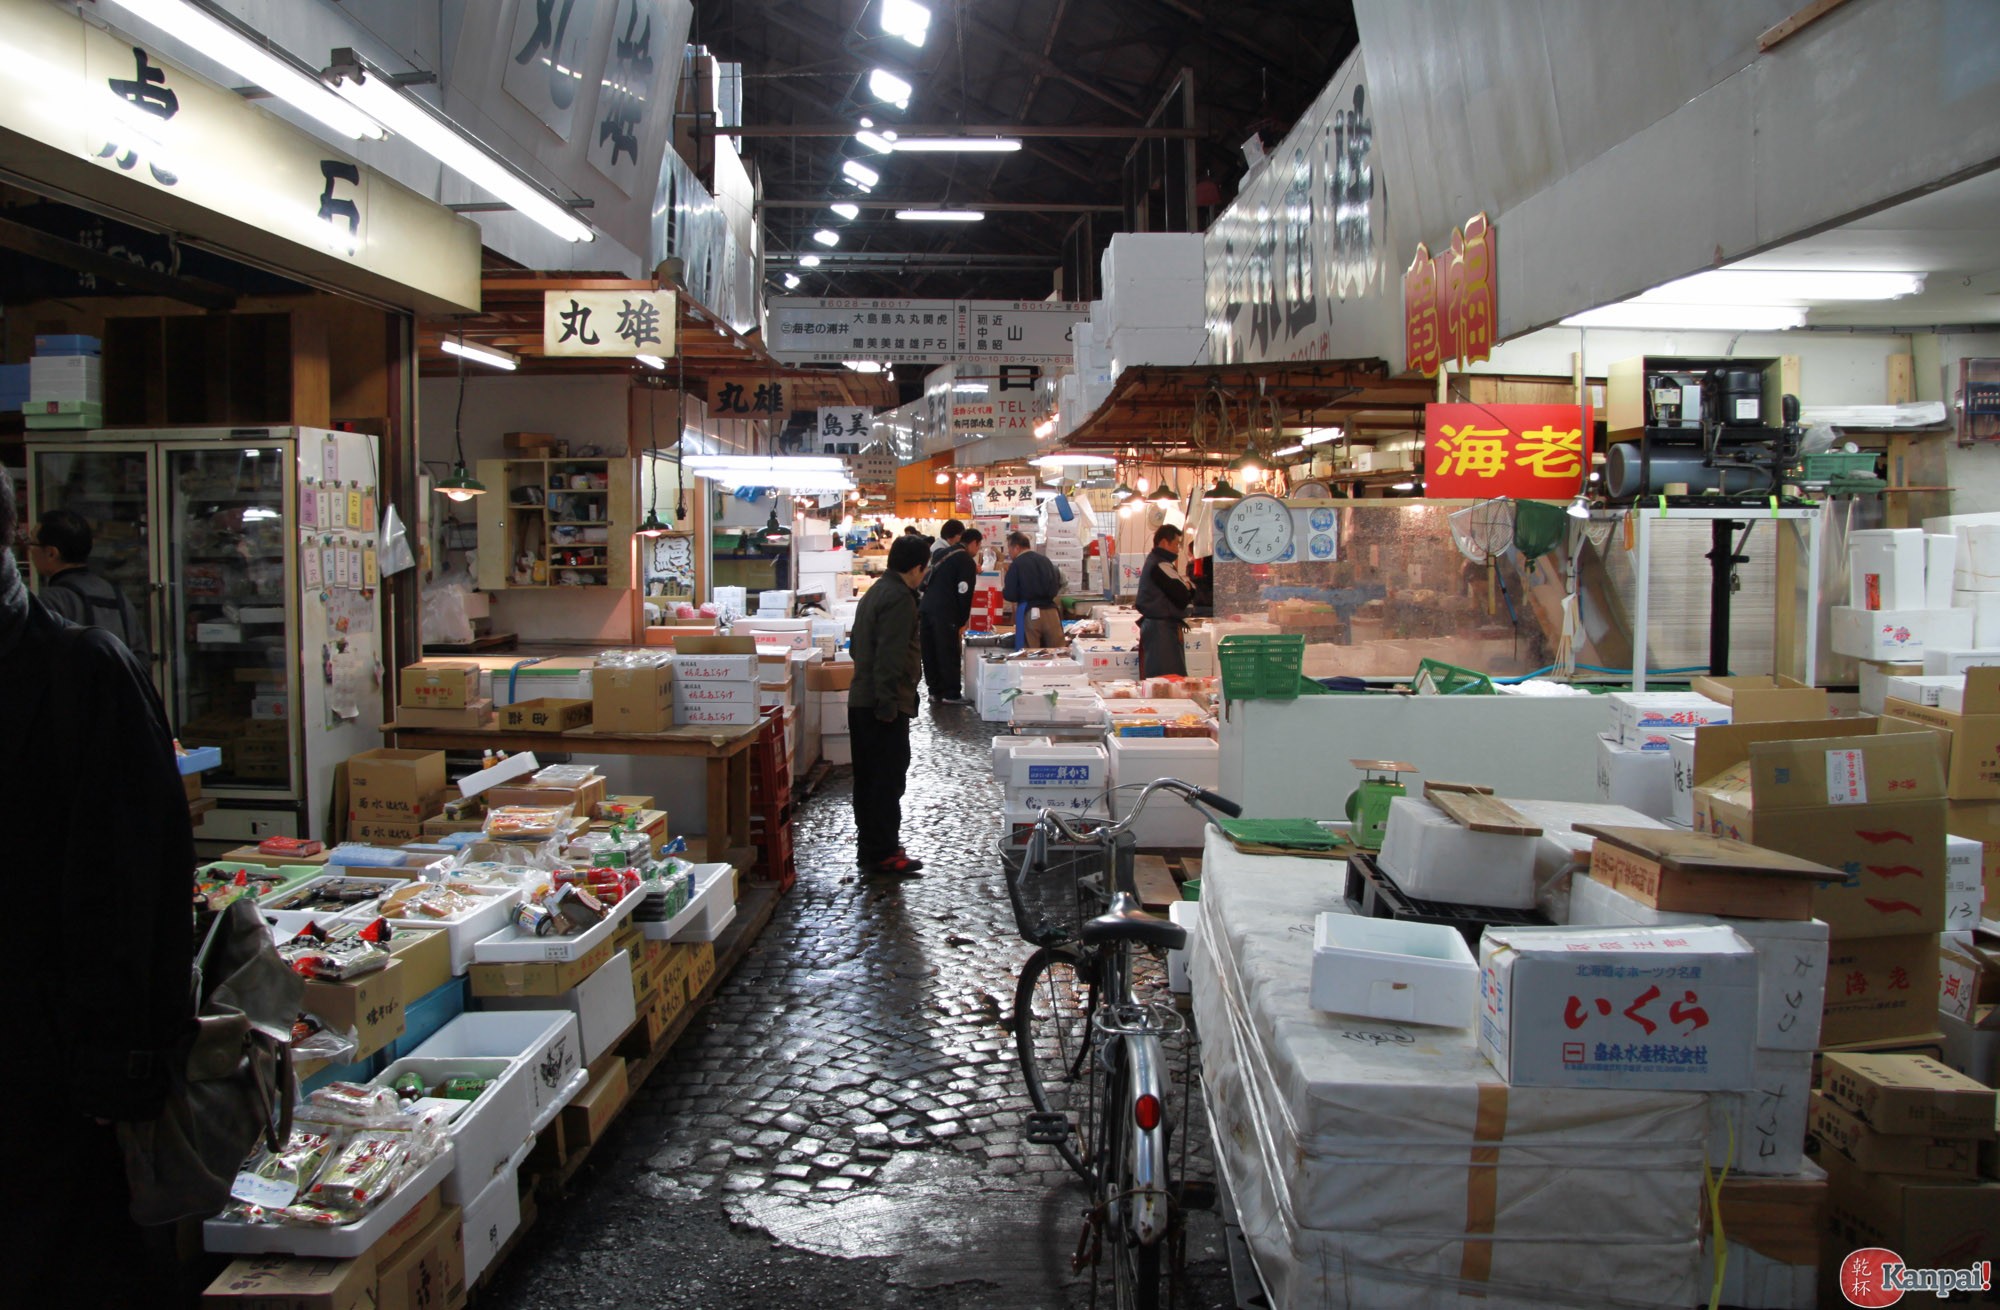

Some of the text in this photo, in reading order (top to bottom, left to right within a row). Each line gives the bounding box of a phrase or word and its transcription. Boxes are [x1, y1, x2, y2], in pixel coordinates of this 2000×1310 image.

[557, 298, 662, 348] 丸雄
[714, 381, 784, 414] 丸雄
[1000, 400, 1026, 414] TEL
[822, 412, 870, 437] 島美
[999, 415, 1027, 429] FAX
[1434, 424, 1583, 479] 海老
[1255, 503, 1263, 511] 12
[1237, 513, 1245, 522] 10
[1275, 513, 1281, 522] 2
[1233, 525, 1239, 533] 9
[1278, 524, 1284, 533] 3
[1238, 536, 1243, 545] 8
[1274, 536, 1280, 544] 4
[1255, 547, 1261, 555] 6
[1266, 544, 1272, 552] 5
[1949, 902, 1973, 919] 13
[1563, 984, 1710, 1037] いくら
